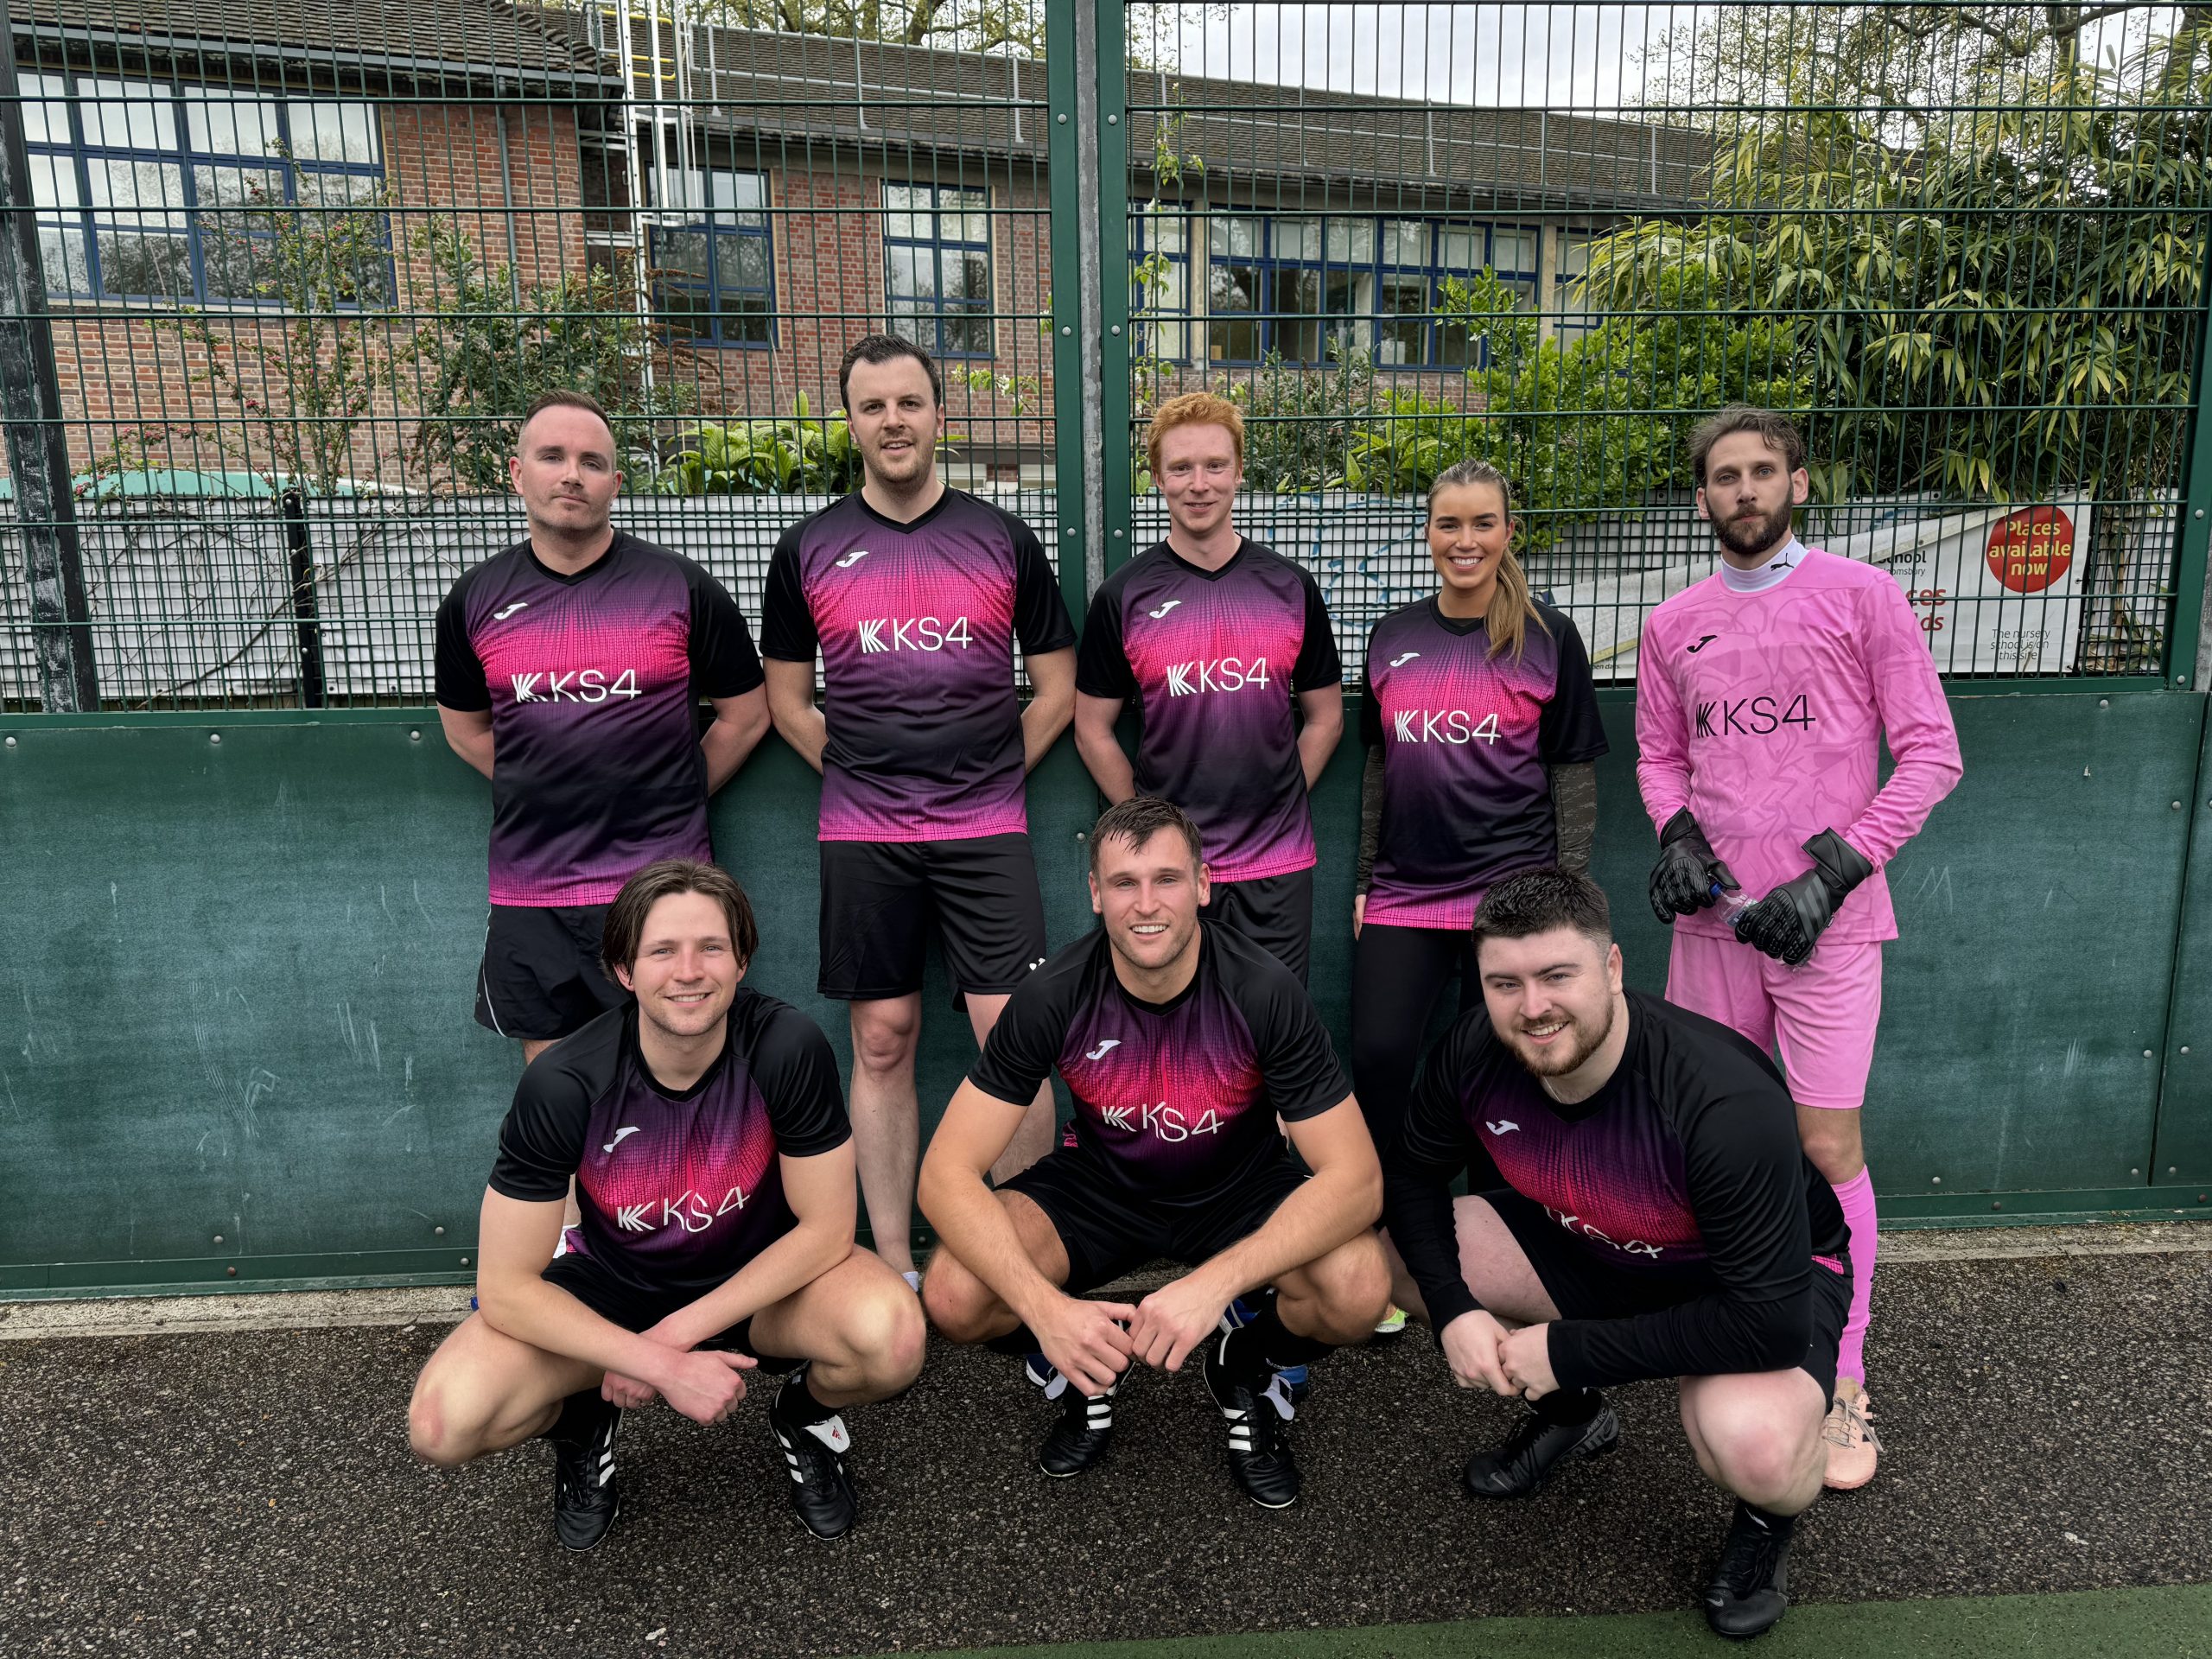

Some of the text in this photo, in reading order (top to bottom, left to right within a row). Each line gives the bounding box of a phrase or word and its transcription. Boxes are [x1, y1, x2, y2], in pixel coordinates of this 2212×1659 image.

[2005, 520, 2061, 537] Places
[1989, 540, 2072, 558] available
[2011, 563, 2048, 575] now
[1992, 629, 2050, 640] The nursery
